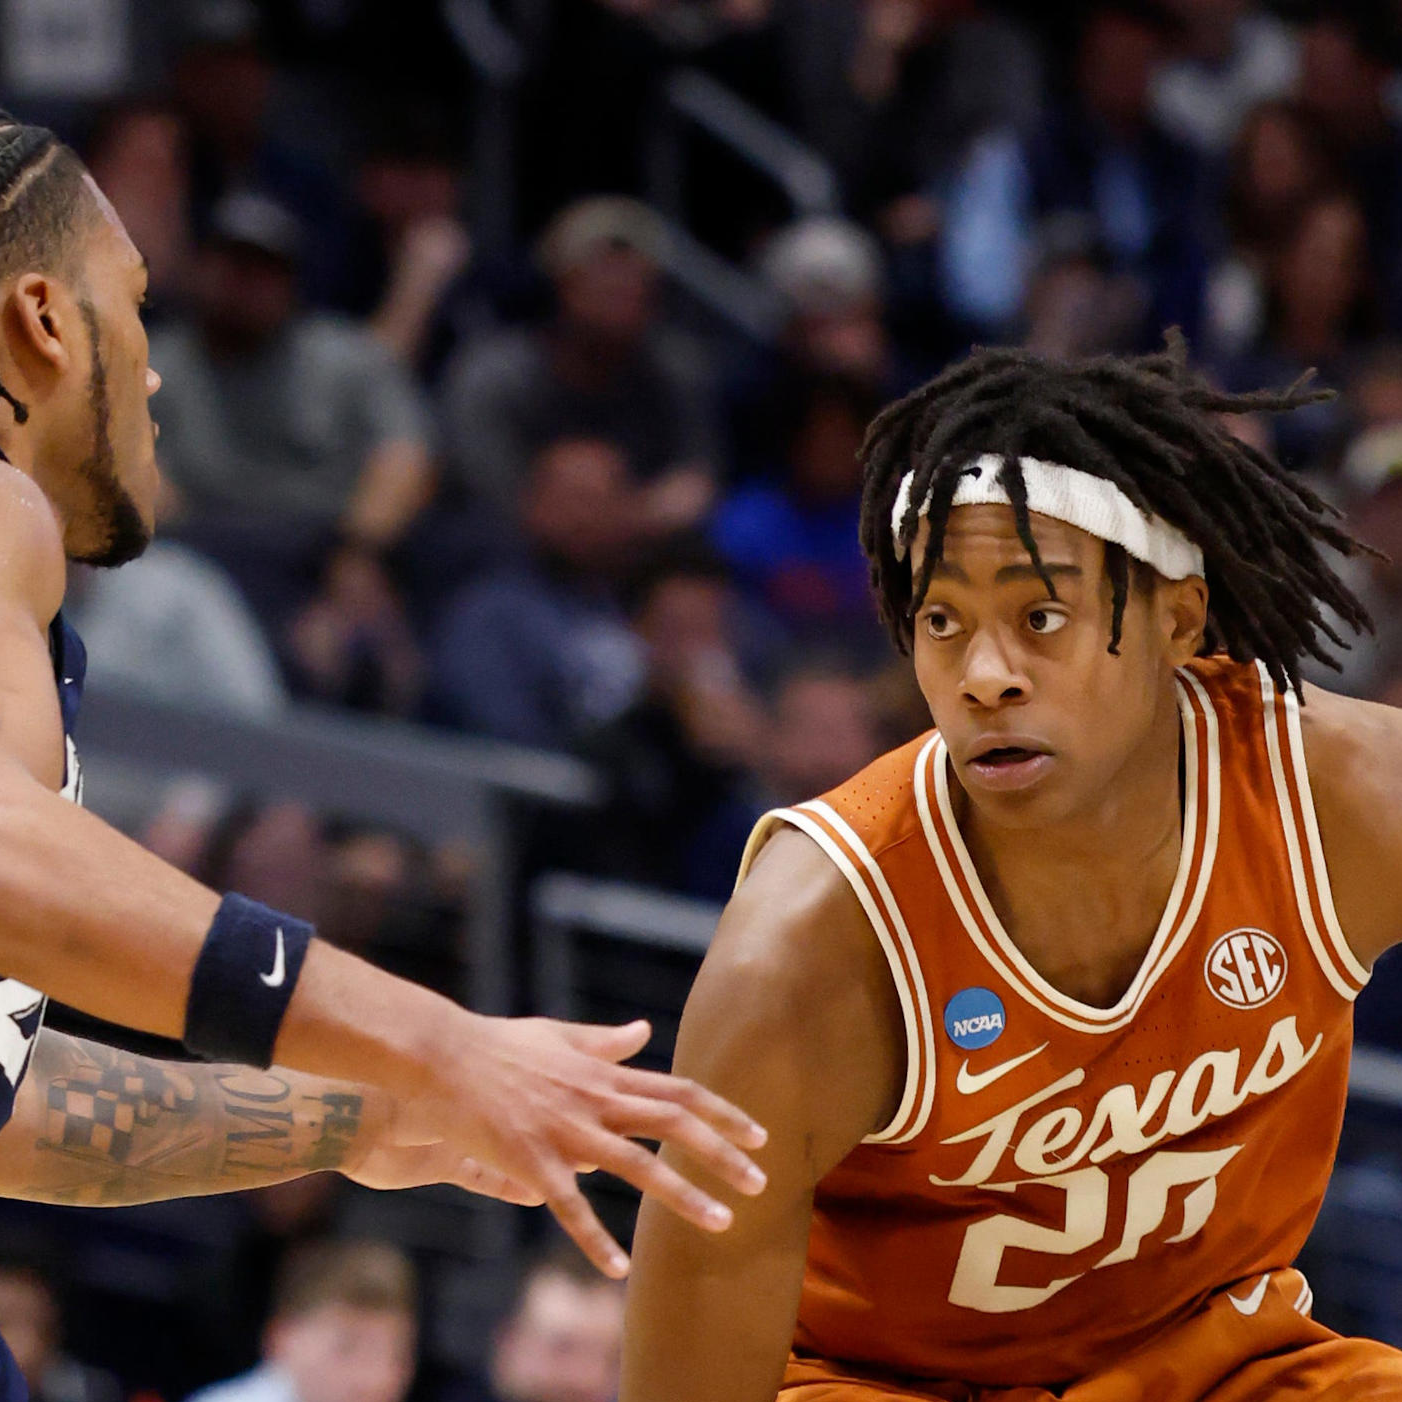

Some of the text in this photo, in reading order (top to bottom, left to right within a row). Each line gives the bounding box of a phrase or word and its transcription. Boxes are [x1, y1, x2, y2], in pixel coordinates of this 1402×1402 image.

[953, 1012, 1003, 1037] NCAA
[1211, 933, 1283, 1005] SEC
[929, 1015, 1323, 1187] Texas
[948, 1143, 1246, 1314] 20
